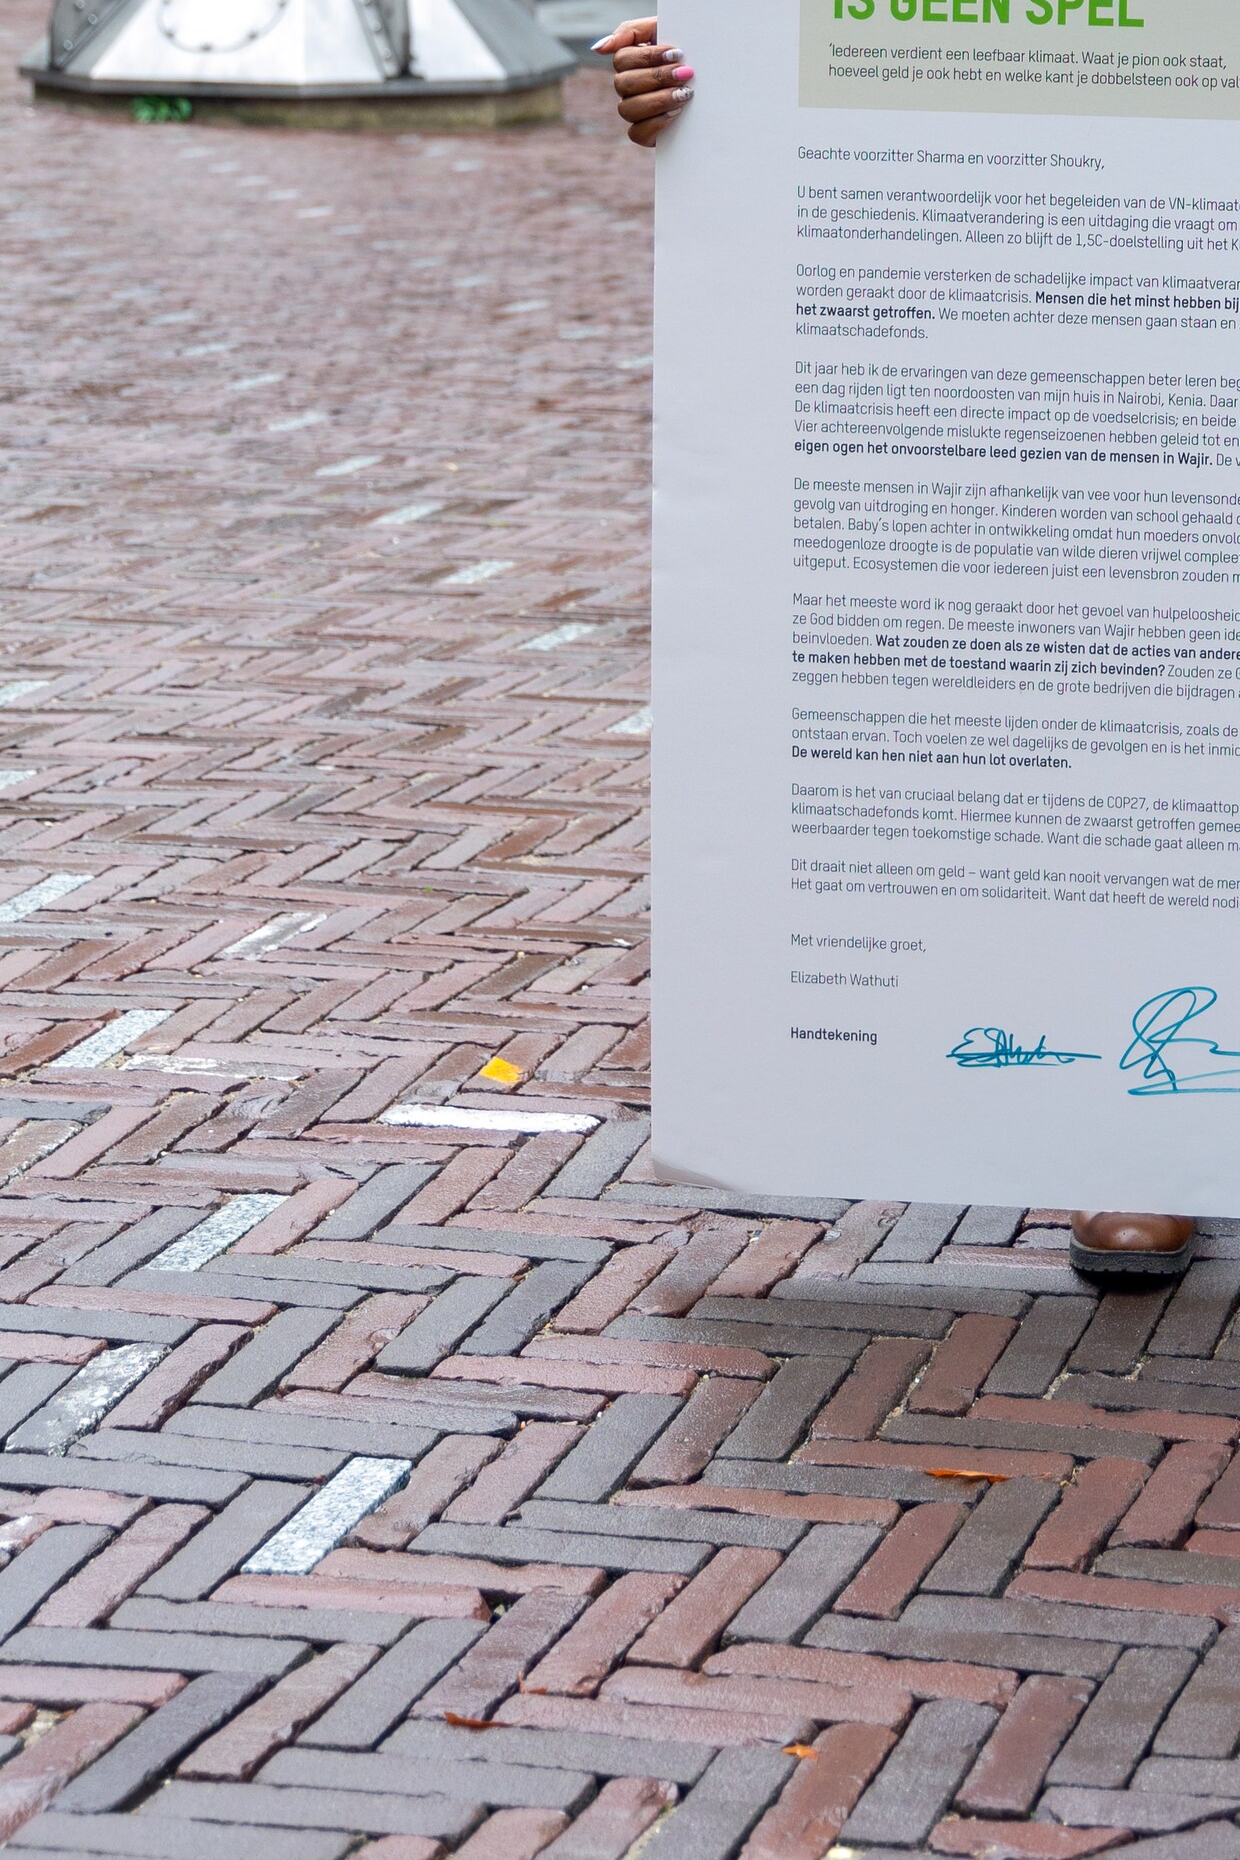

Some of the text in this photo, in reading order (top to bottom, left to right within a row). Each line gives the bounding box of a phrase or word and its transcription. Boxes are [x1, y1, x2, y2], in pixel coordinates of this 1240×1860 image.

[890, 45, 943, 60] verdient
[945, 49, 970, 61] een
[972, 47, 1026, 63] leefbaar
[1028, 49, 1078, 64] klimaat.
[1081, 50, 1115, 65] Waat
[1116, 51, 1129, 69] je
[1131, 52, 1160, 69] pion
[1162, 53, 1187, 67] ook
[1188, 53, 1227, 70] staat,
[828, 63, 879, 78] hoeveel
[881, 65, 909, 82] geld
[910, 65, 924, 83] je
[926, 66, 950, 80] ook
[952, 67, 983, 81] hebt
[984, 70, 1002, 82] en
[1004, 68, 1042, 83] welke
[1045, 69, 1074, 84] kant
[1075, 70, 1088, 87] je
[1090, 71, 1172, 86] dobbelsteen
[1174, 73, 1199, 87] ook
[1201, 77, 1218, 91] op
[797, 146, 1105, 171] Geachte voorzitter Sharma en voorzitter Shoukry,
[797, 184, 806, 199] U
[808, 185, 838, 199] bent
[840, 189, 884, 201] samen
[886, 188, 992, 207] verantwoordelijk
[994, 193, 1022, 205] voor
[1025, 191, 1046, 206] het
[1049, 192, 1121, 210] begeleiden
[1123, 198, 1147, 209] van
[1149, 196, 1166, 210] de
[796, 224, 962, 245] klimaatonderhandelingen.
[964, 229, 1004, 244] Alleen
[1006, 233, 1022, 245] zo
[1025, 231, 1053, 248] blijft
[1055, 232, 1072, 246] de
[1075, 232, 1184, 252] 1,5C-doelstelling
[1186, 236, 1204, 250] uit
[1206, 236, 1228, 251] het
[795, 283, 843, 297] worden
[846, 285, 895, 300] geraakt
[897, 285, 927, 300] door
[929, 287, 945, 301] de
[948, 287, 1032, 304] klimaatcrisis.
[1035, 290, 1084, 305] Mensen
[1086, 292, 1107, 306] die
[1109, 292, 1132, 307] het
[1134, 293, 1170, 308] minst
[1172, 294, 1221, 310] hebben
[793, 438, 829, 455] eigen
[832, 442, 864, 456] ogen
[866, 440, 889, 454] het
[891, 443, 987, 458] onvoorstelbare
[989, 444, 1017, 459] leed
[1019, 446, 1062, 463] gezien
[1064, 450, 1087, 461] van
[1090, 448, 1106, 462] de
[1109, 451, 1160, 464] mensen
[1162, 450, 1175, 465] in
[1177, 451, 1213, 469] Wajir.
[1215, 452, 1233, 467] De
[792, 553, 850, 571] uitgeput.
[852, 555, 938, 573] Ecosystemen
[940, 559, 960, 573] die
[962, 563, 990, 574] voor
[993, 561, 1049, 576] iedereen
[1050, 563, 1079, 580] juist
[1081, 567, 1106, 578] een
[1108, 565, 1179, 581] levensbron
[1181, 569, 1229, 583] zouden
[791, 744, 1072, 769] De wereld kan hen niet aan hun lot overlaten.
[790, 821, 870, 836] weerbaarder
[872, 823, 909, 840] tegen
[911, 825, 991, 845] toekomstige
[993, 829, 1044, 844] schade.
[1046, 831, 1079, 845] Want
[1082, 832, 1102, 846] die
[1104, 833, 1151, 848] schade
[1153, 836, 1183, 852] gaat
[1185, 837, 1224, 851] alleen
[790, 932, 926, 954] Met vriendelijke groet,
[790, 970, 898, 988] Elizabeth Wathuti
[790, 1026, 878, 1045] Handtekening
